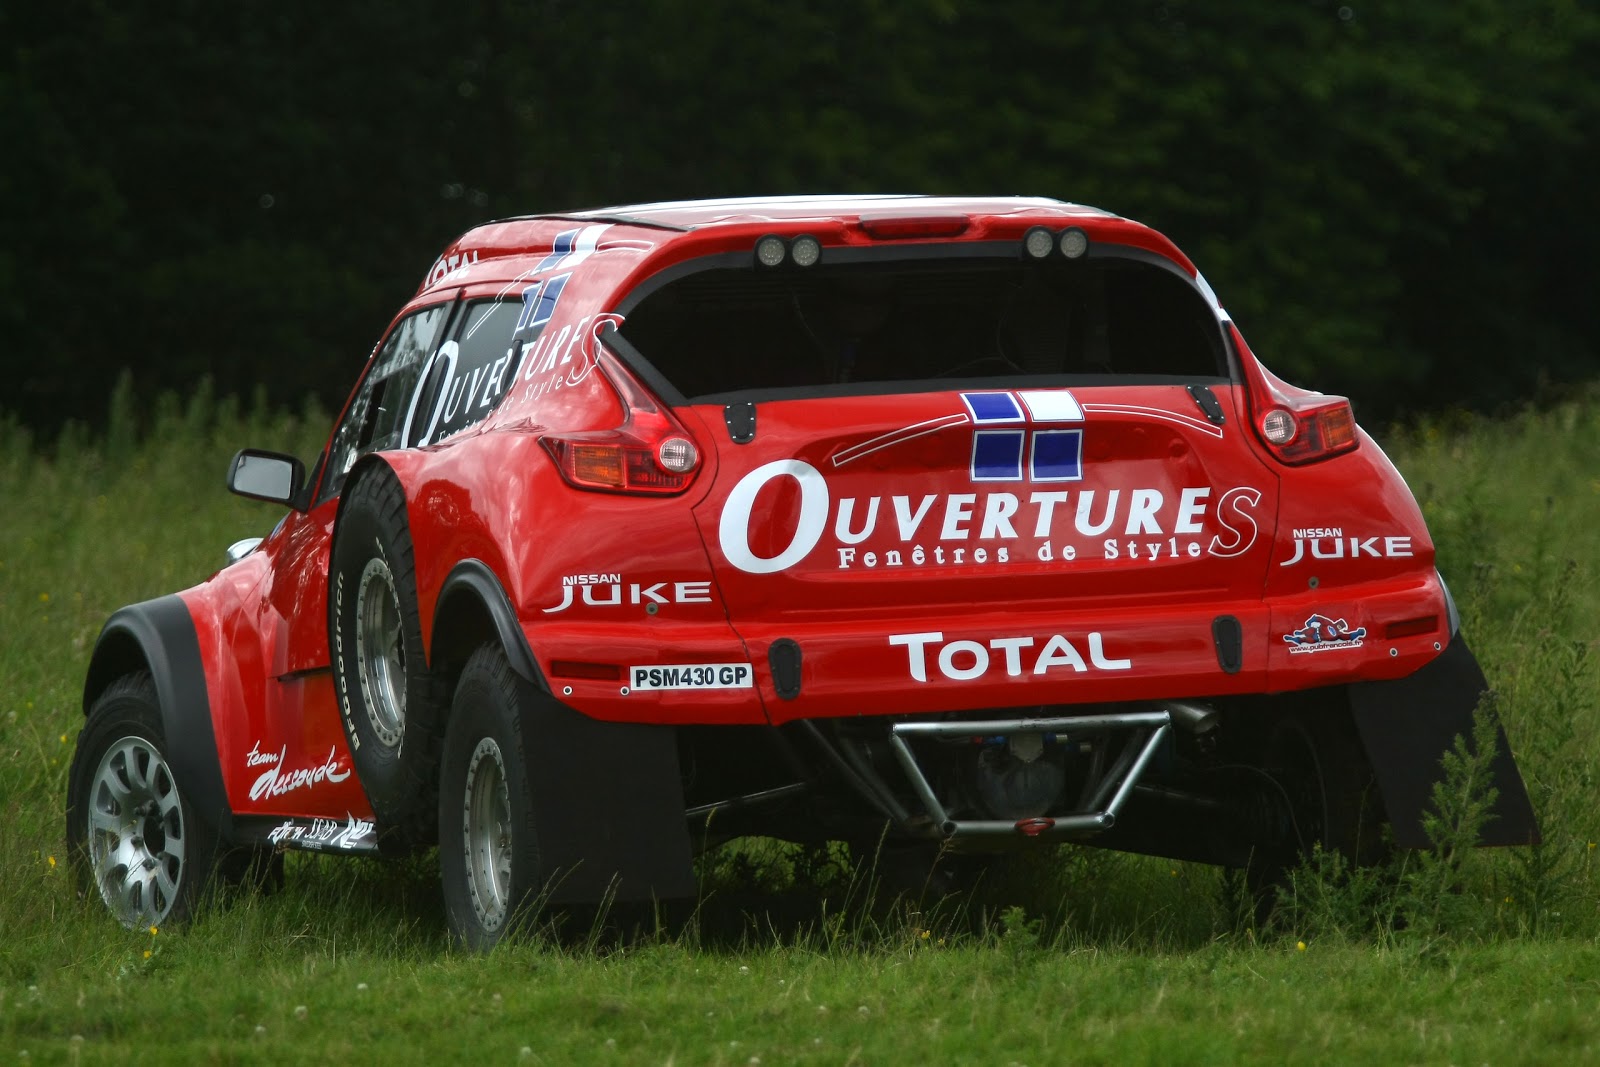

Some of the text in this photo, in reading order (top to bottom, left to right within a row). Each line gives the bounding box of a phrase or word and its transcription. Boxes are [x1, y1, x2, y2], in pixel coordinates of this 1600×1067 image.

[521, 374, 564, 405] Style
[718, 459, 1262, 574] OUVERTURES
[1293, 528, 1343, 538] NISSAN
[837, 537, 1201, 568] Fenêtres de Style
[1280, 536, 1414, 566] JUKE
[562, 573, 621, 585] NISSAN
[542, 581, 713, 613] JUKE
[336, 571, 360, 750] BFGoodrich
[889, 632, 1131, 682] TOTAL
[635, 666, 748, 688] PSM430 GP
[247, 740, 279, 767] team
